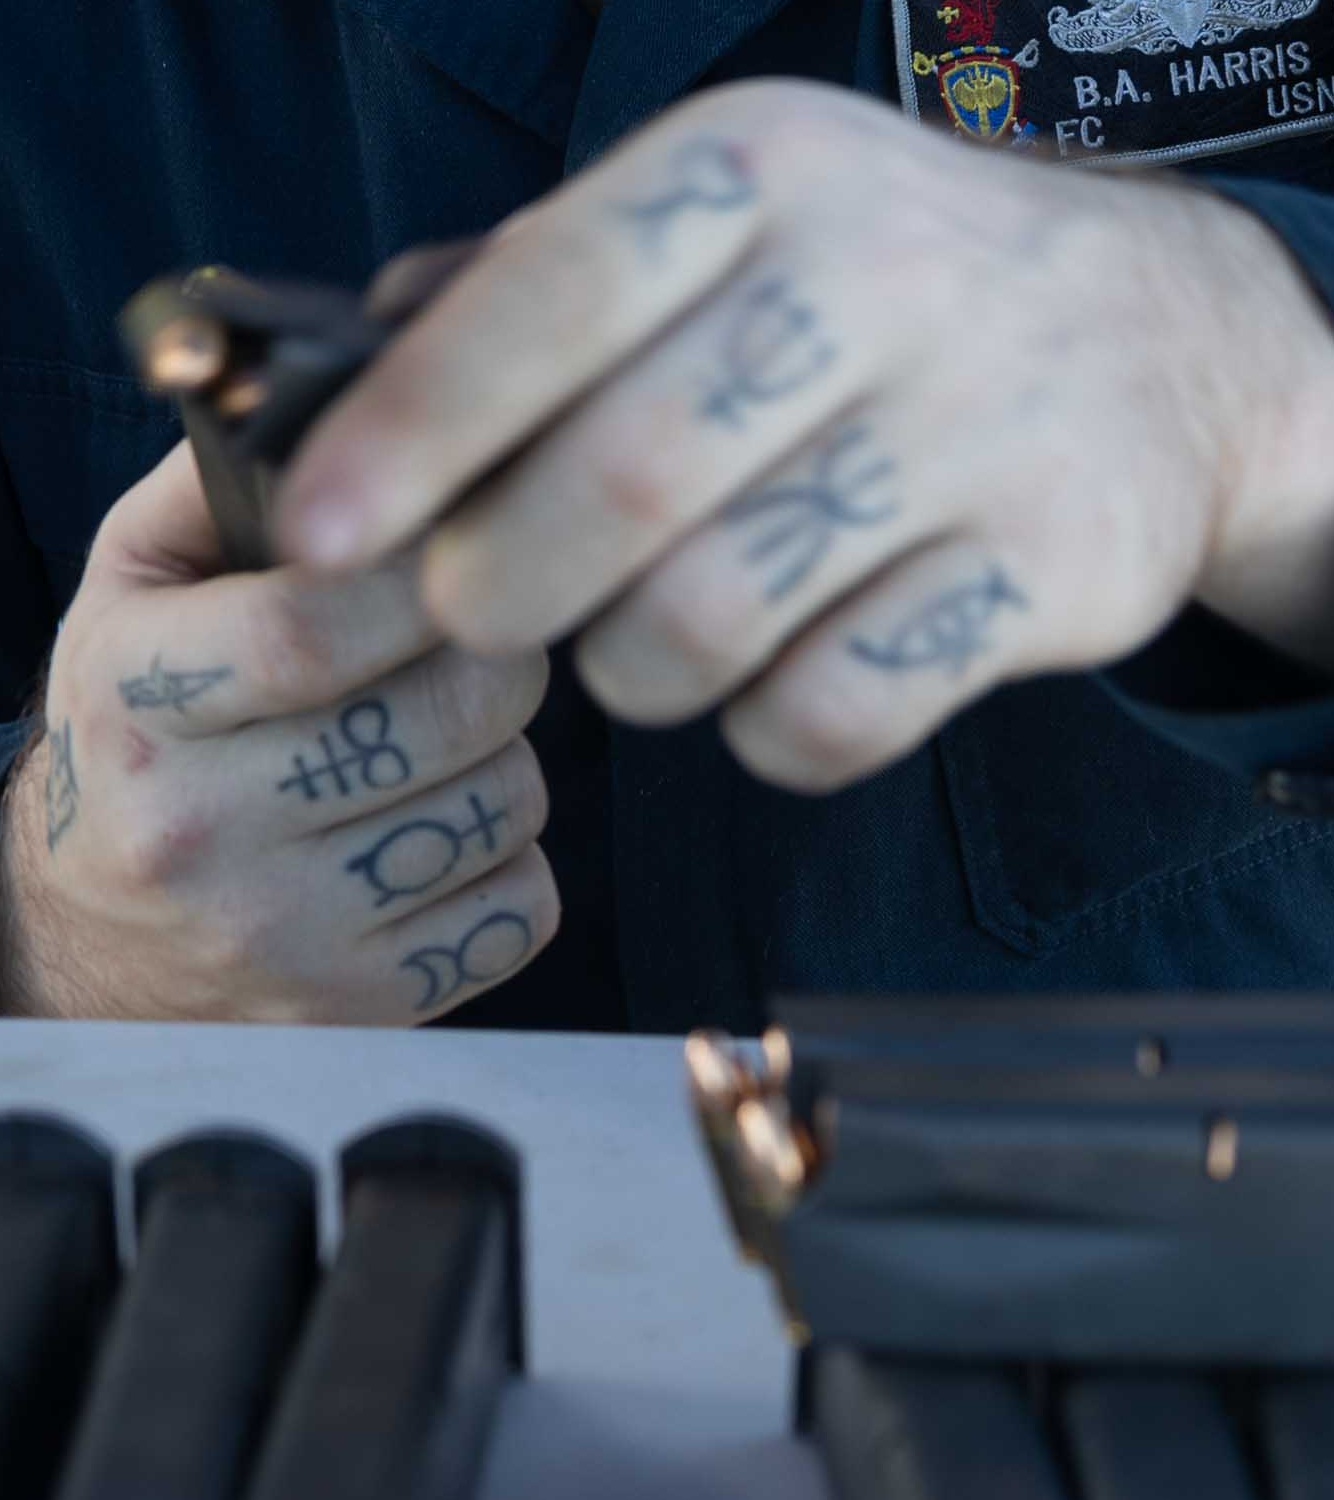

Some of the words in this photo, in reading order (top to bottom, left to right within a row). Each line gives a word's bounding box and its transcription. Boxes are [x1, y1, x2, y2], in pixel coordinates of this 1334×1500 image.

[1073, 68, 1153, 110] B.A.
[1169, 40, 1311, 97] HARRIS
[1055, 115, 1106, 158] FC
